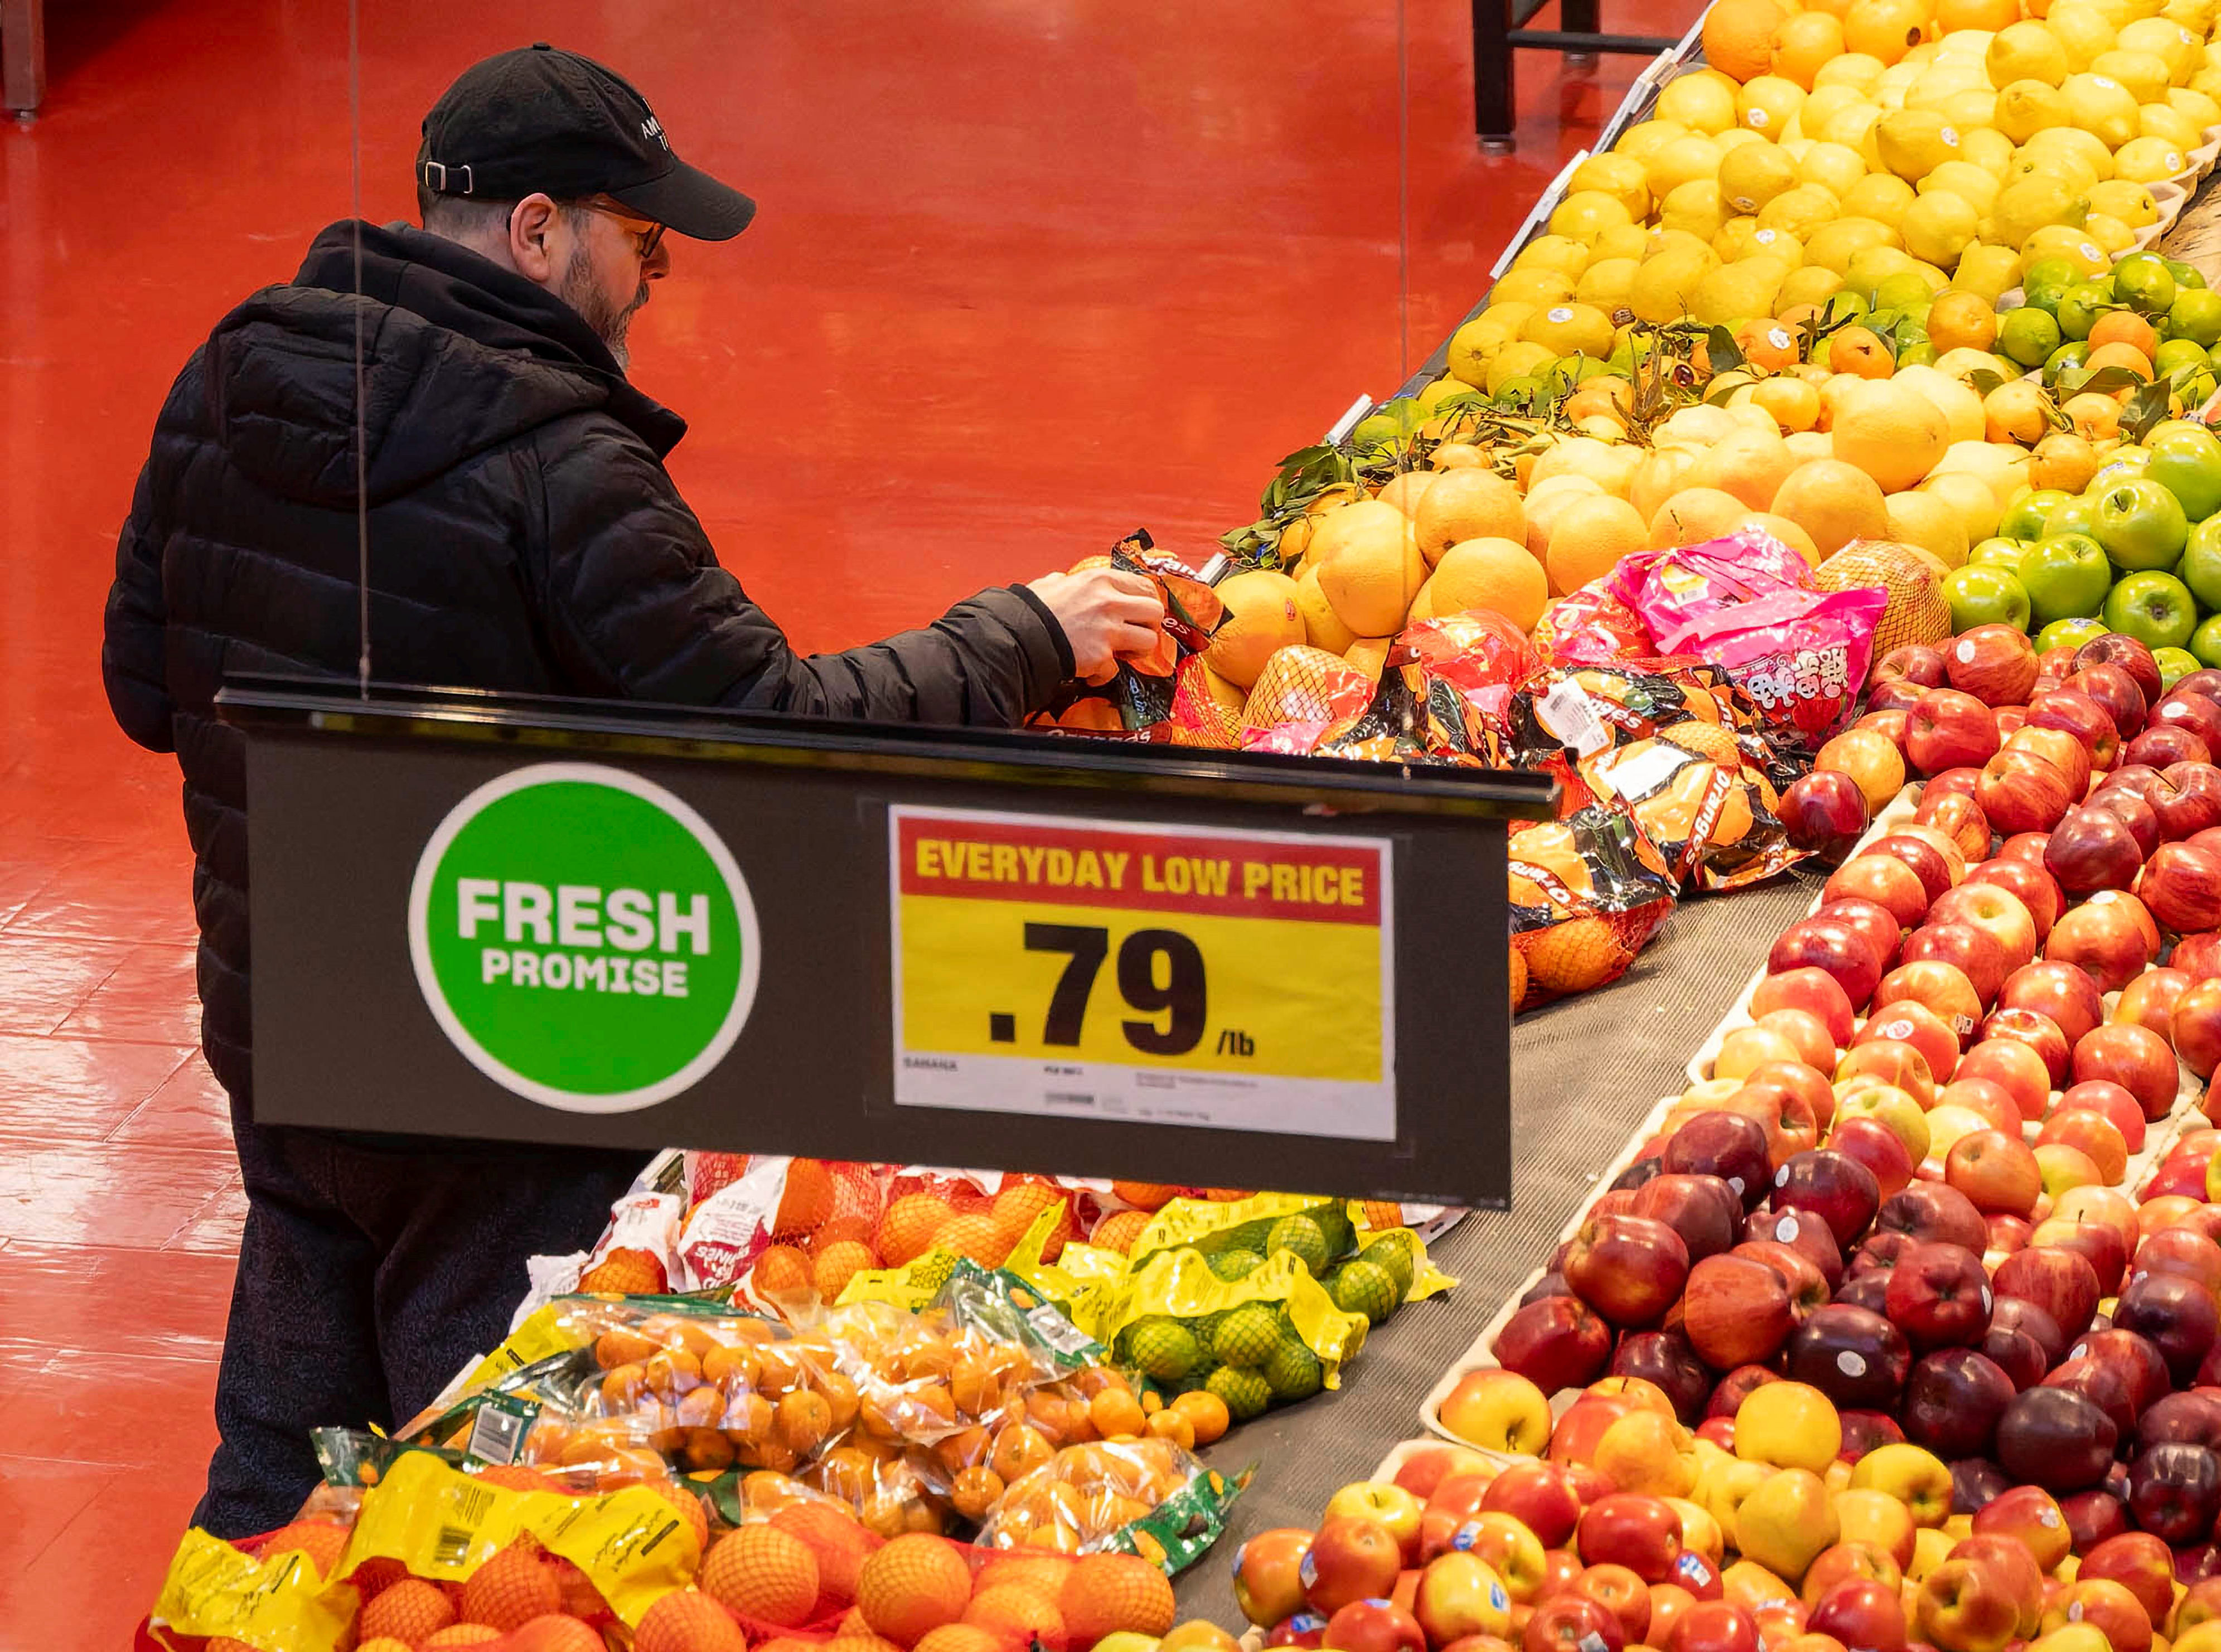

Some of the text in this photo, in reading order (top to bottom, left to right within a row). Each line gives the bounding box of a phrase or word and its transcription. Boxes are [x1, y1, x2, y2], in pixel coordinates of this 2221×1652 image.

[916, 839, 1364, 906] EVERYDAY LOW PRICE
[457, 877, 710, 956] FRESH
[481, 948, 689, 998] PROMISE
[989, 922, 1255, 1058] .79 /lb
